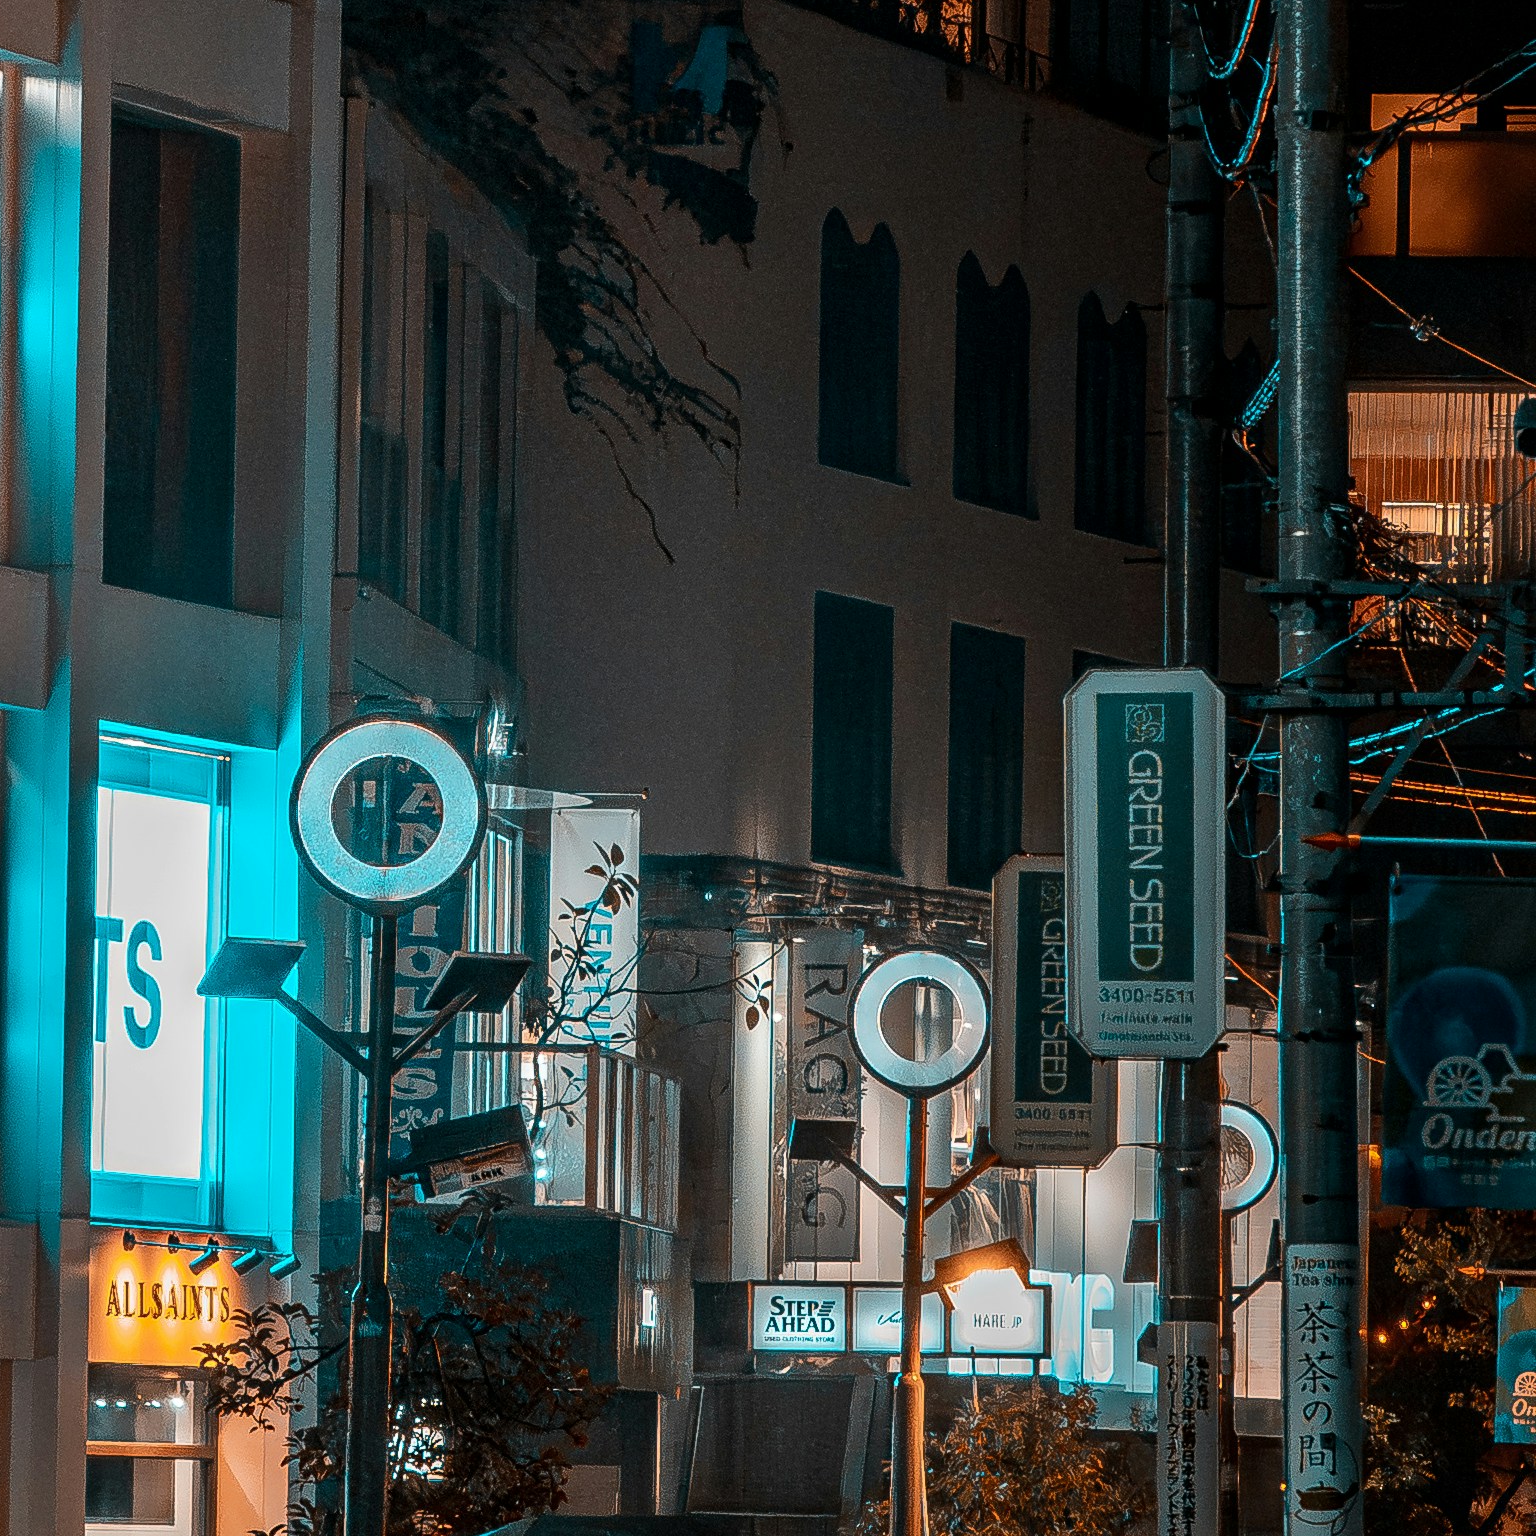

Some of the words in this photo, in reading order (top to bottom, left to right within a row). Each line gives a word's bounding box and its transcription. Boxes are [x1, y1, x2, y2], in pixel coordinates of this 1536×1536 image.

[1127, 750, 1163, 872] GREEN
[1040, 918, 1066, 1015] GREEN
[1129, 877, 1163, 972] SEED
[1040, 1020, 1068, 1095] SEED
[105, 1280, 231, 1323] ALLSAINTS
[1292, 1273, 1319, 1286] Tea
[765, 1316, 835, 1332] AHEAD
[1293, 1300, 1338, 1476] 茶茶の間
